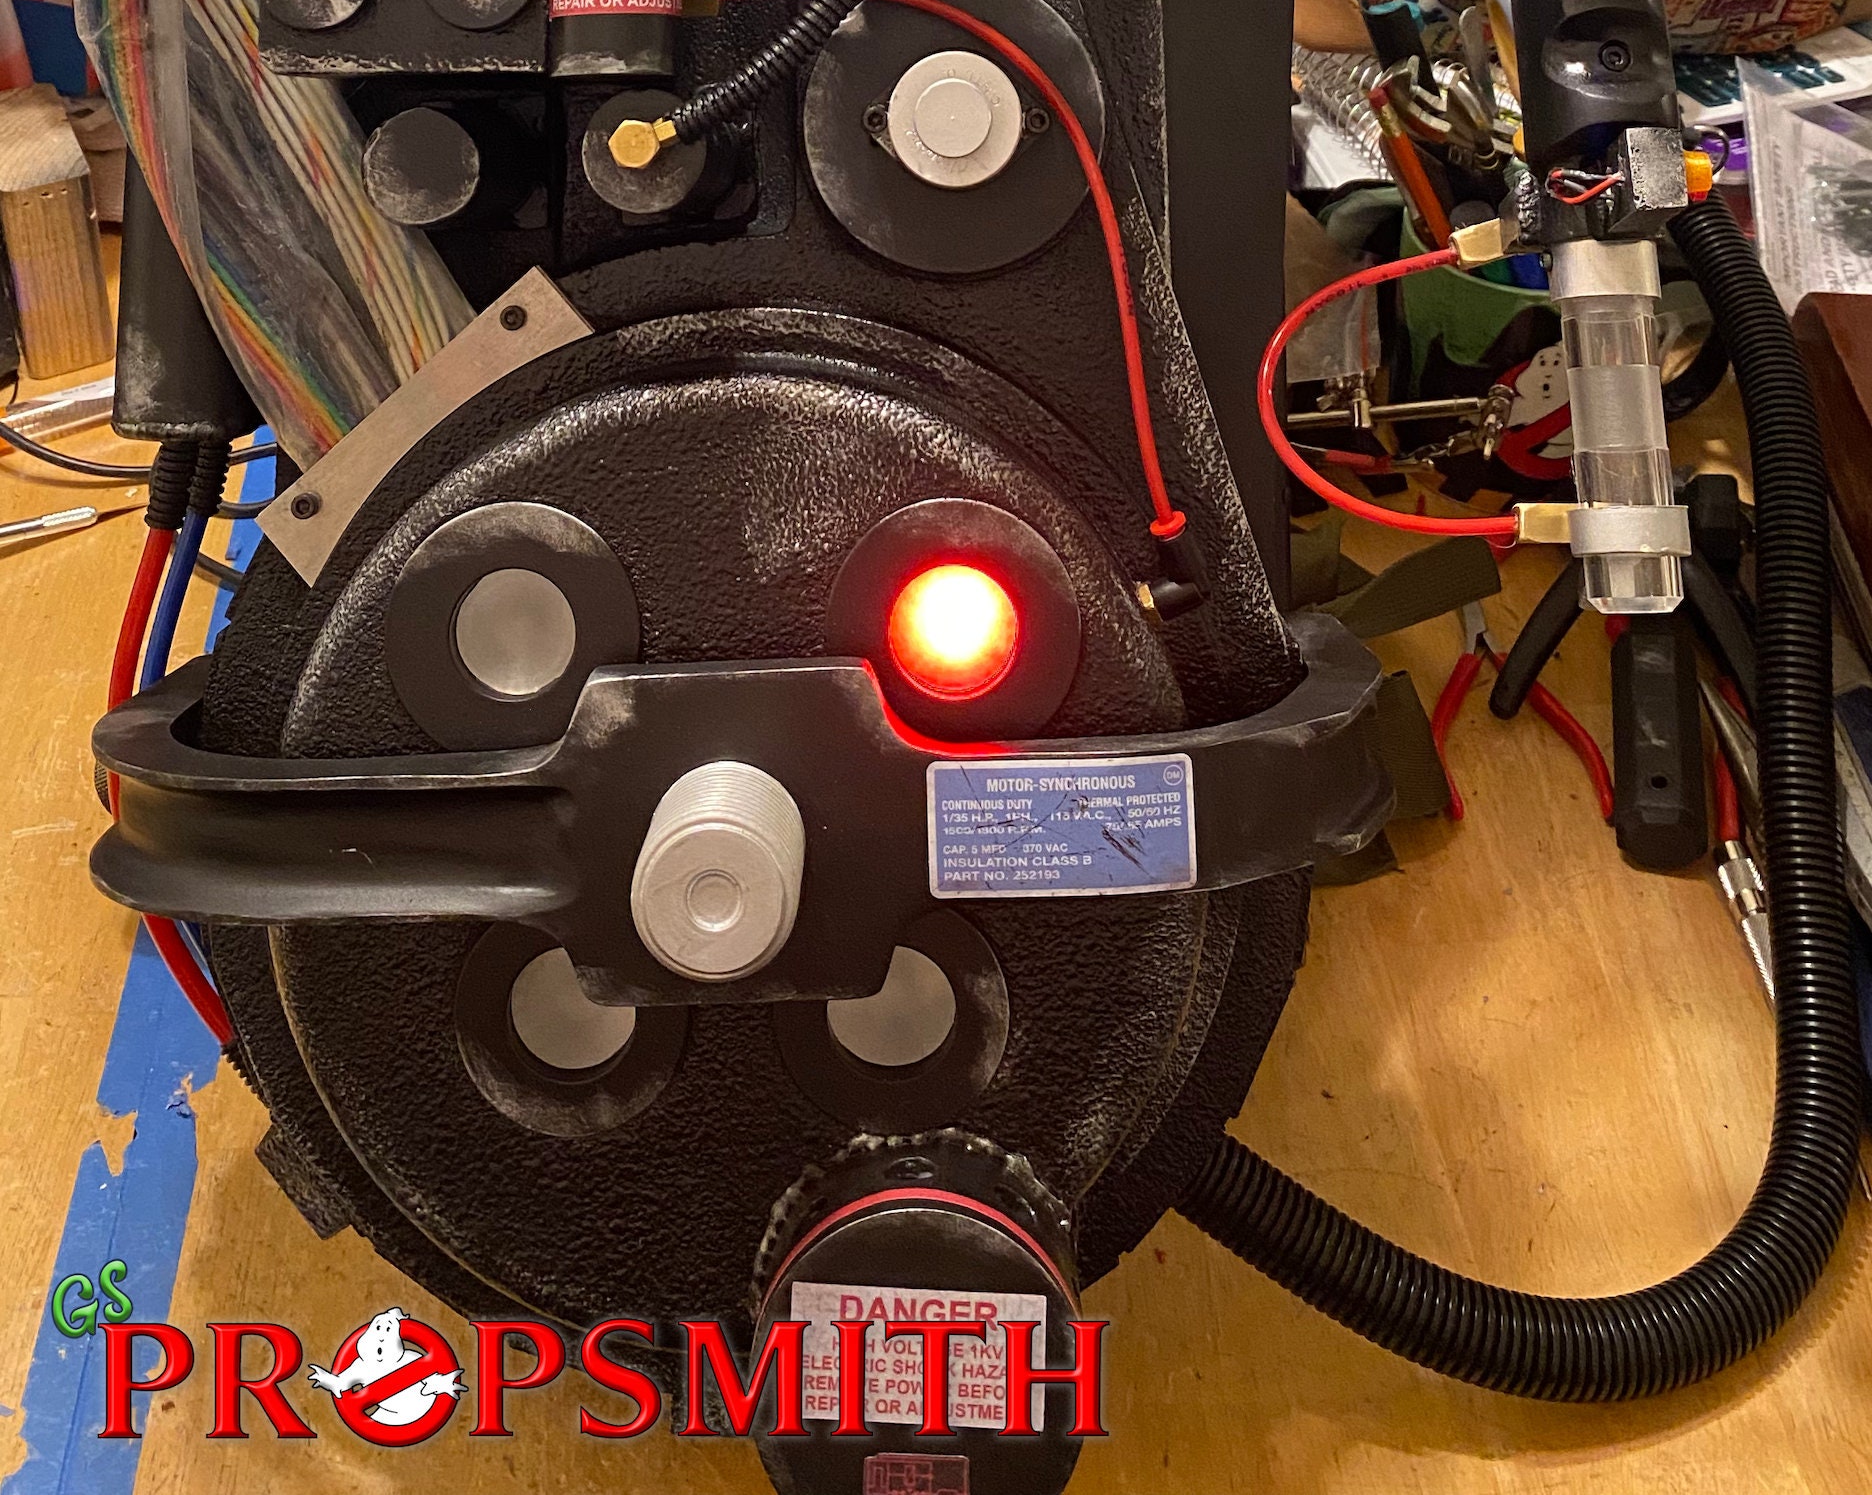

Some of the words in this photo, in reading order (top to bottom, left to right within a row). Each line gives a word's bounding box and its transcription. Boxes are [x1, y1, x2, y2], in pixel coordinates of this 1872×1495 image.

[986, 774, 1136, 793] MOTOR-SYNCHRONOUS
[941, 799, 1004, 811] CONTINUOUS
[1006, 798, 1033, 810] DUTY
[1126, 791, 1181, 806] PROTECTED
[943, 812, 969, 823] 1/35
[1163, 804, 1182, 815] HZ
[1144, 816, 1182, 829] AMPS
[942, 844, 969, 855] CAP.
[971, 844, 978, 855] 5
[1045, 842, 1069, 853] VAC
[943, 856, 1028, 868] INSULATION
[1032, 854, 1079, 867] CLASS
[1082, 854, 1093, 866] B
[943, 870, 980, 881] PART
[983, 870, 1009, 881] NO.
[1012, 868, 1061, 880] 252193
[839, 1294, 998, 1332] DANGER
[874, 1398, 904, 1415] OR
